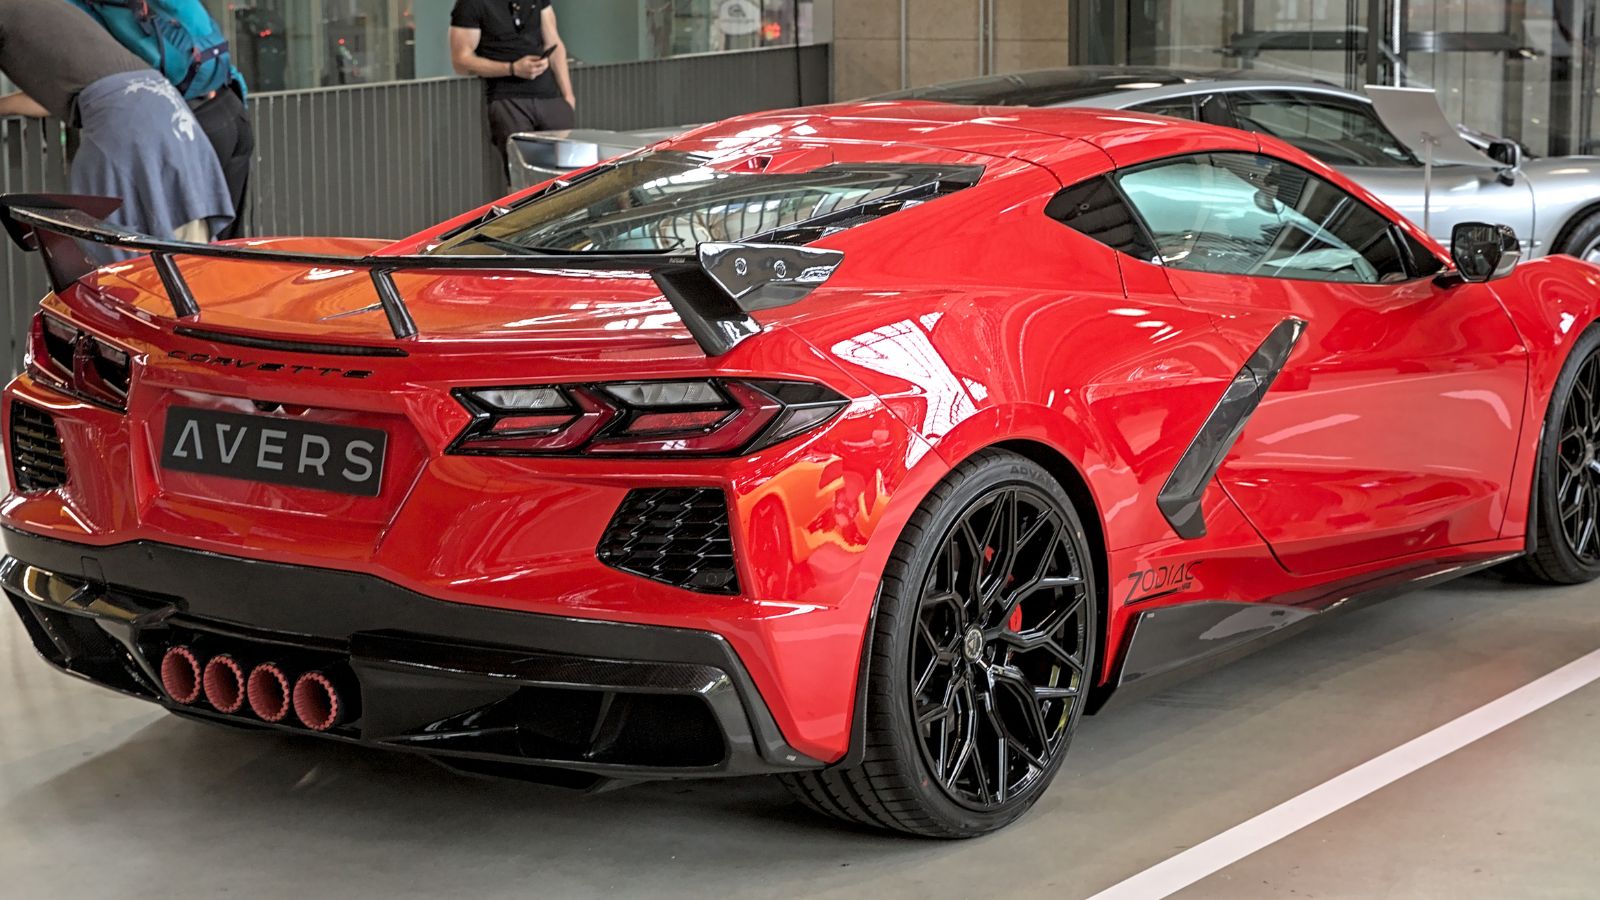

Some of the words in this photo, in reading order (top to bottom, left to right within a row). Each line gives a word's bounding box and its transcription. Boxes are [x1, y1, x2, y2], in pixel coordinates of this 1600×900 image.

[167, 350, 375, 378] CORVETTE
[172, 419, 375, 482] AVERS
[1124, 561, 1203, 607] ZODIAC
